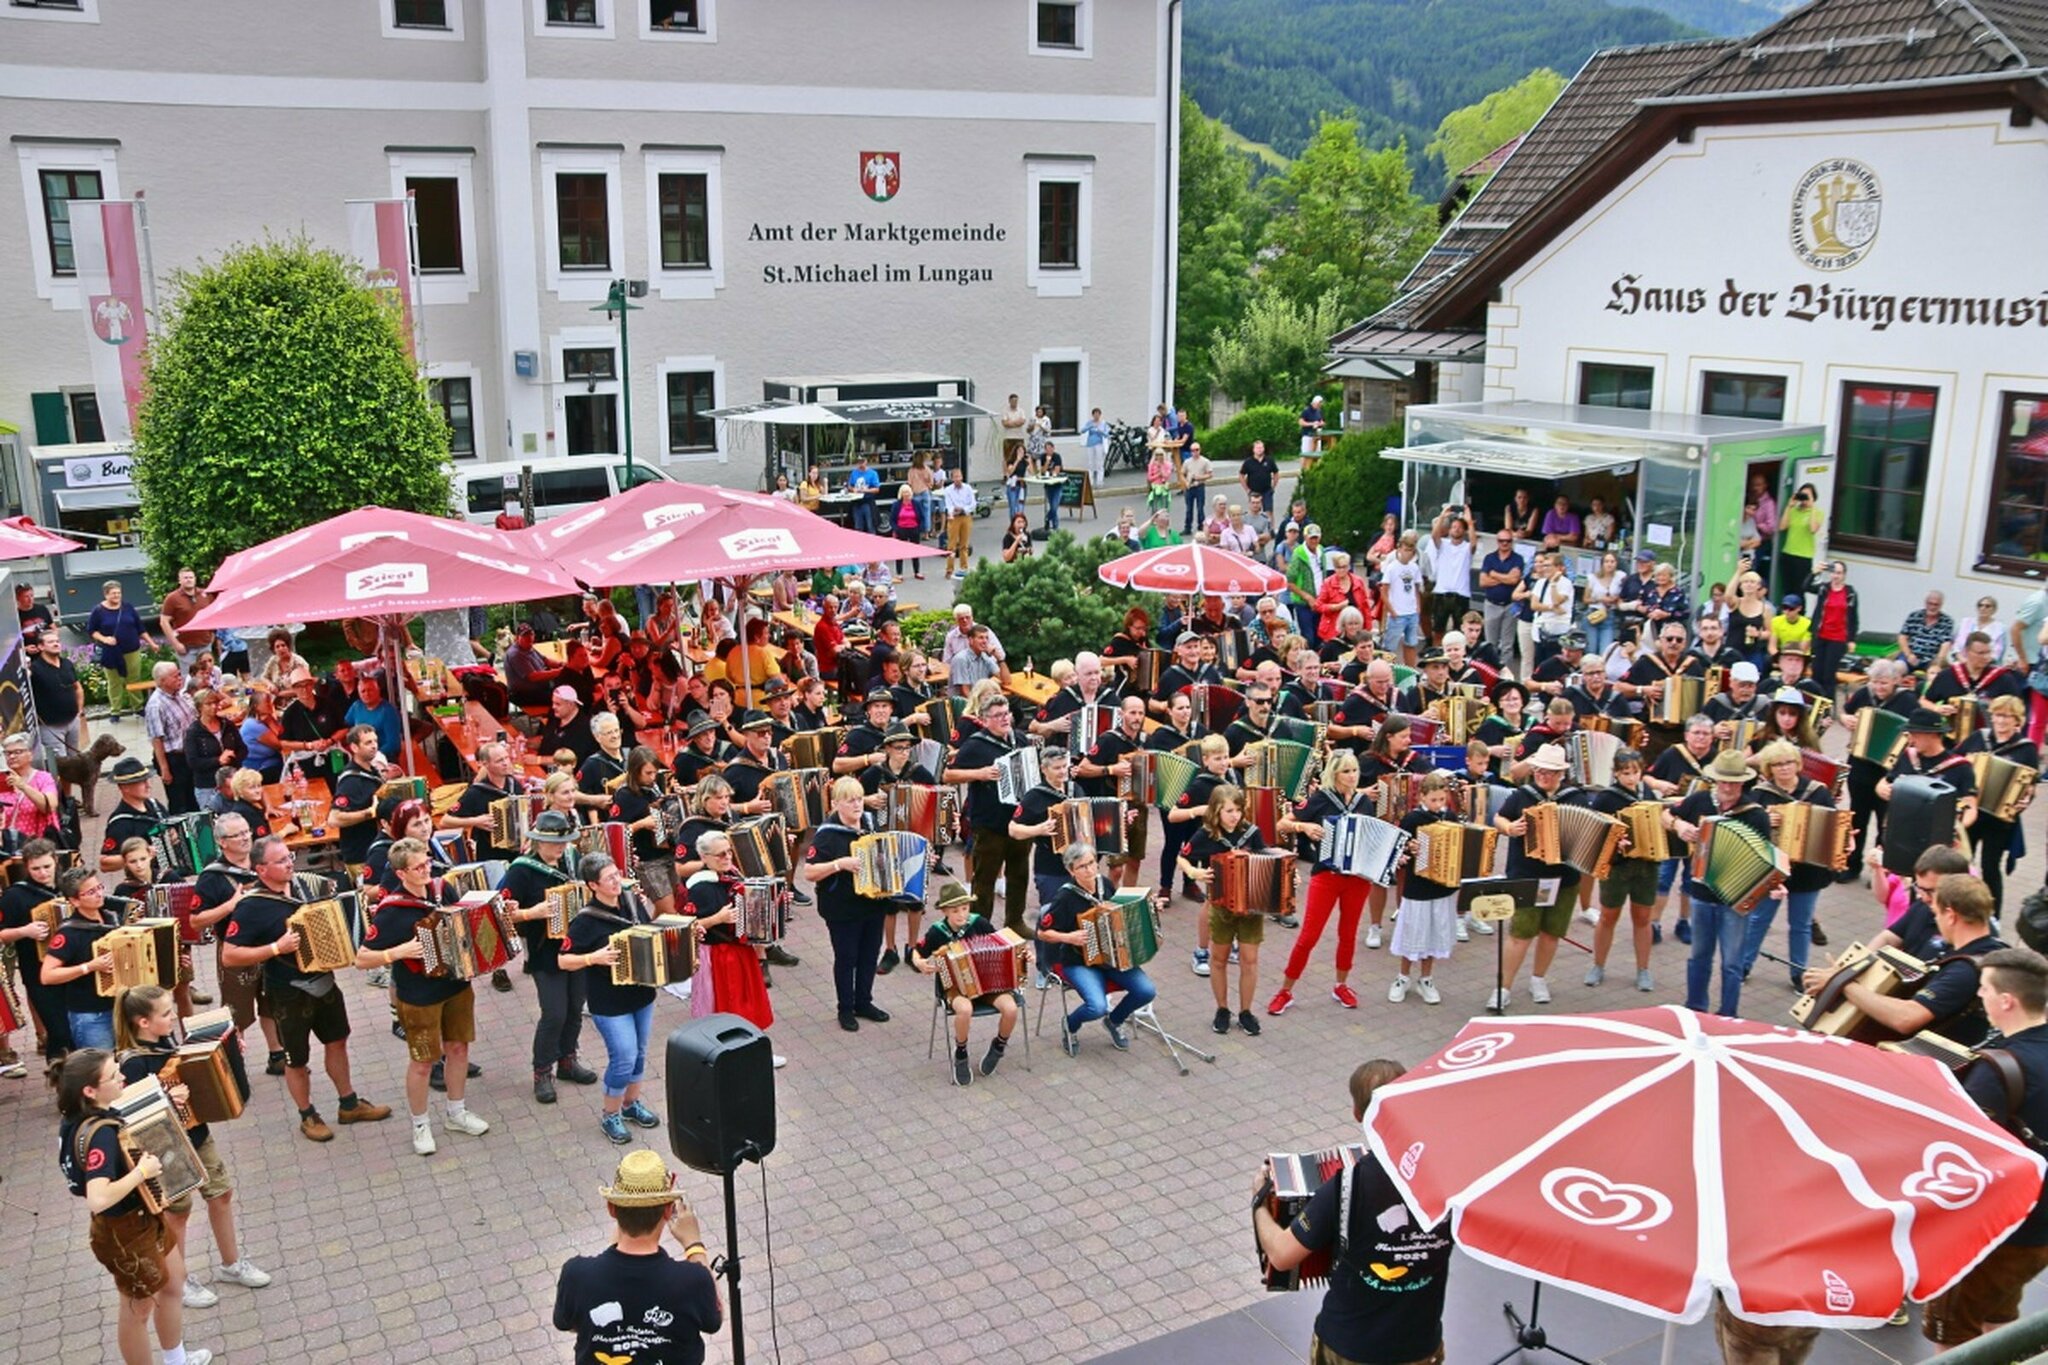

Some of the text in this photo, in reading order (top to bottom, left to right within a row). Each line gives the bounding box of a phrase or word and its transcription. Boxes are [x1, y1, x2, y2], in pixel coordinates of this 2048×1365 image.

[748, 222, 1007, 246] Amt der Marktgemeinde
[763, 264, 994, 286] St.Michael im Lungau
[1604, 272, 1707, 316] Haus
[1717, 278, 1778, 318] der
